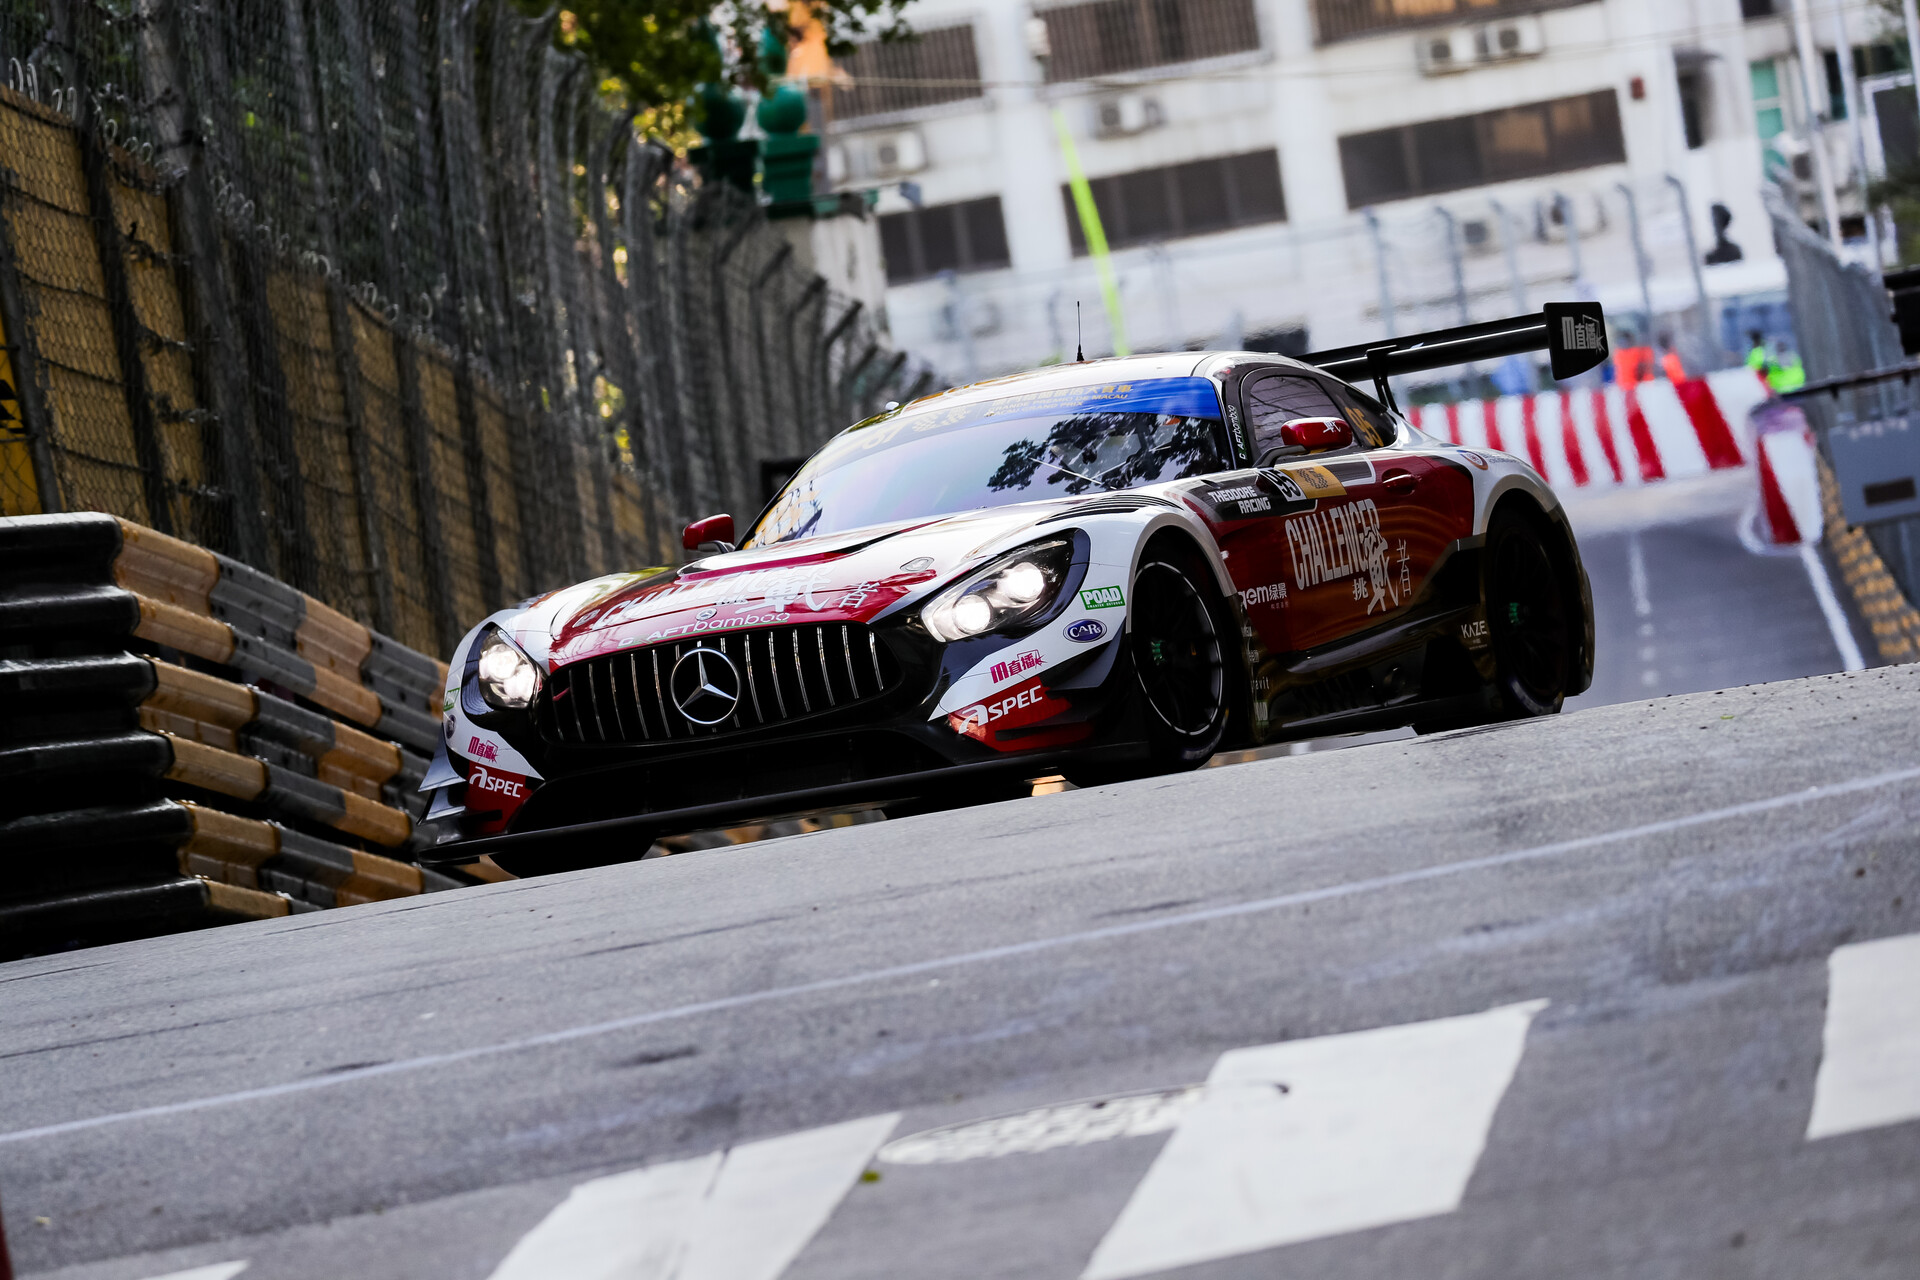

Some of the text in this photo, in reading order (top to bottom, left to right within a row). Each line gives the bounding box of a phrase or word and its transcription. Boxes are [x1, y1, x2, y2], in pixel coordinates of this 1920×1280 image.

[1344, 406, 1385, 448] 95
[1207, 486, 1258, 503] THEODORE
[1237, 496, 1272, 514] RACING
[1081, 587, 1122, 606] POAD
